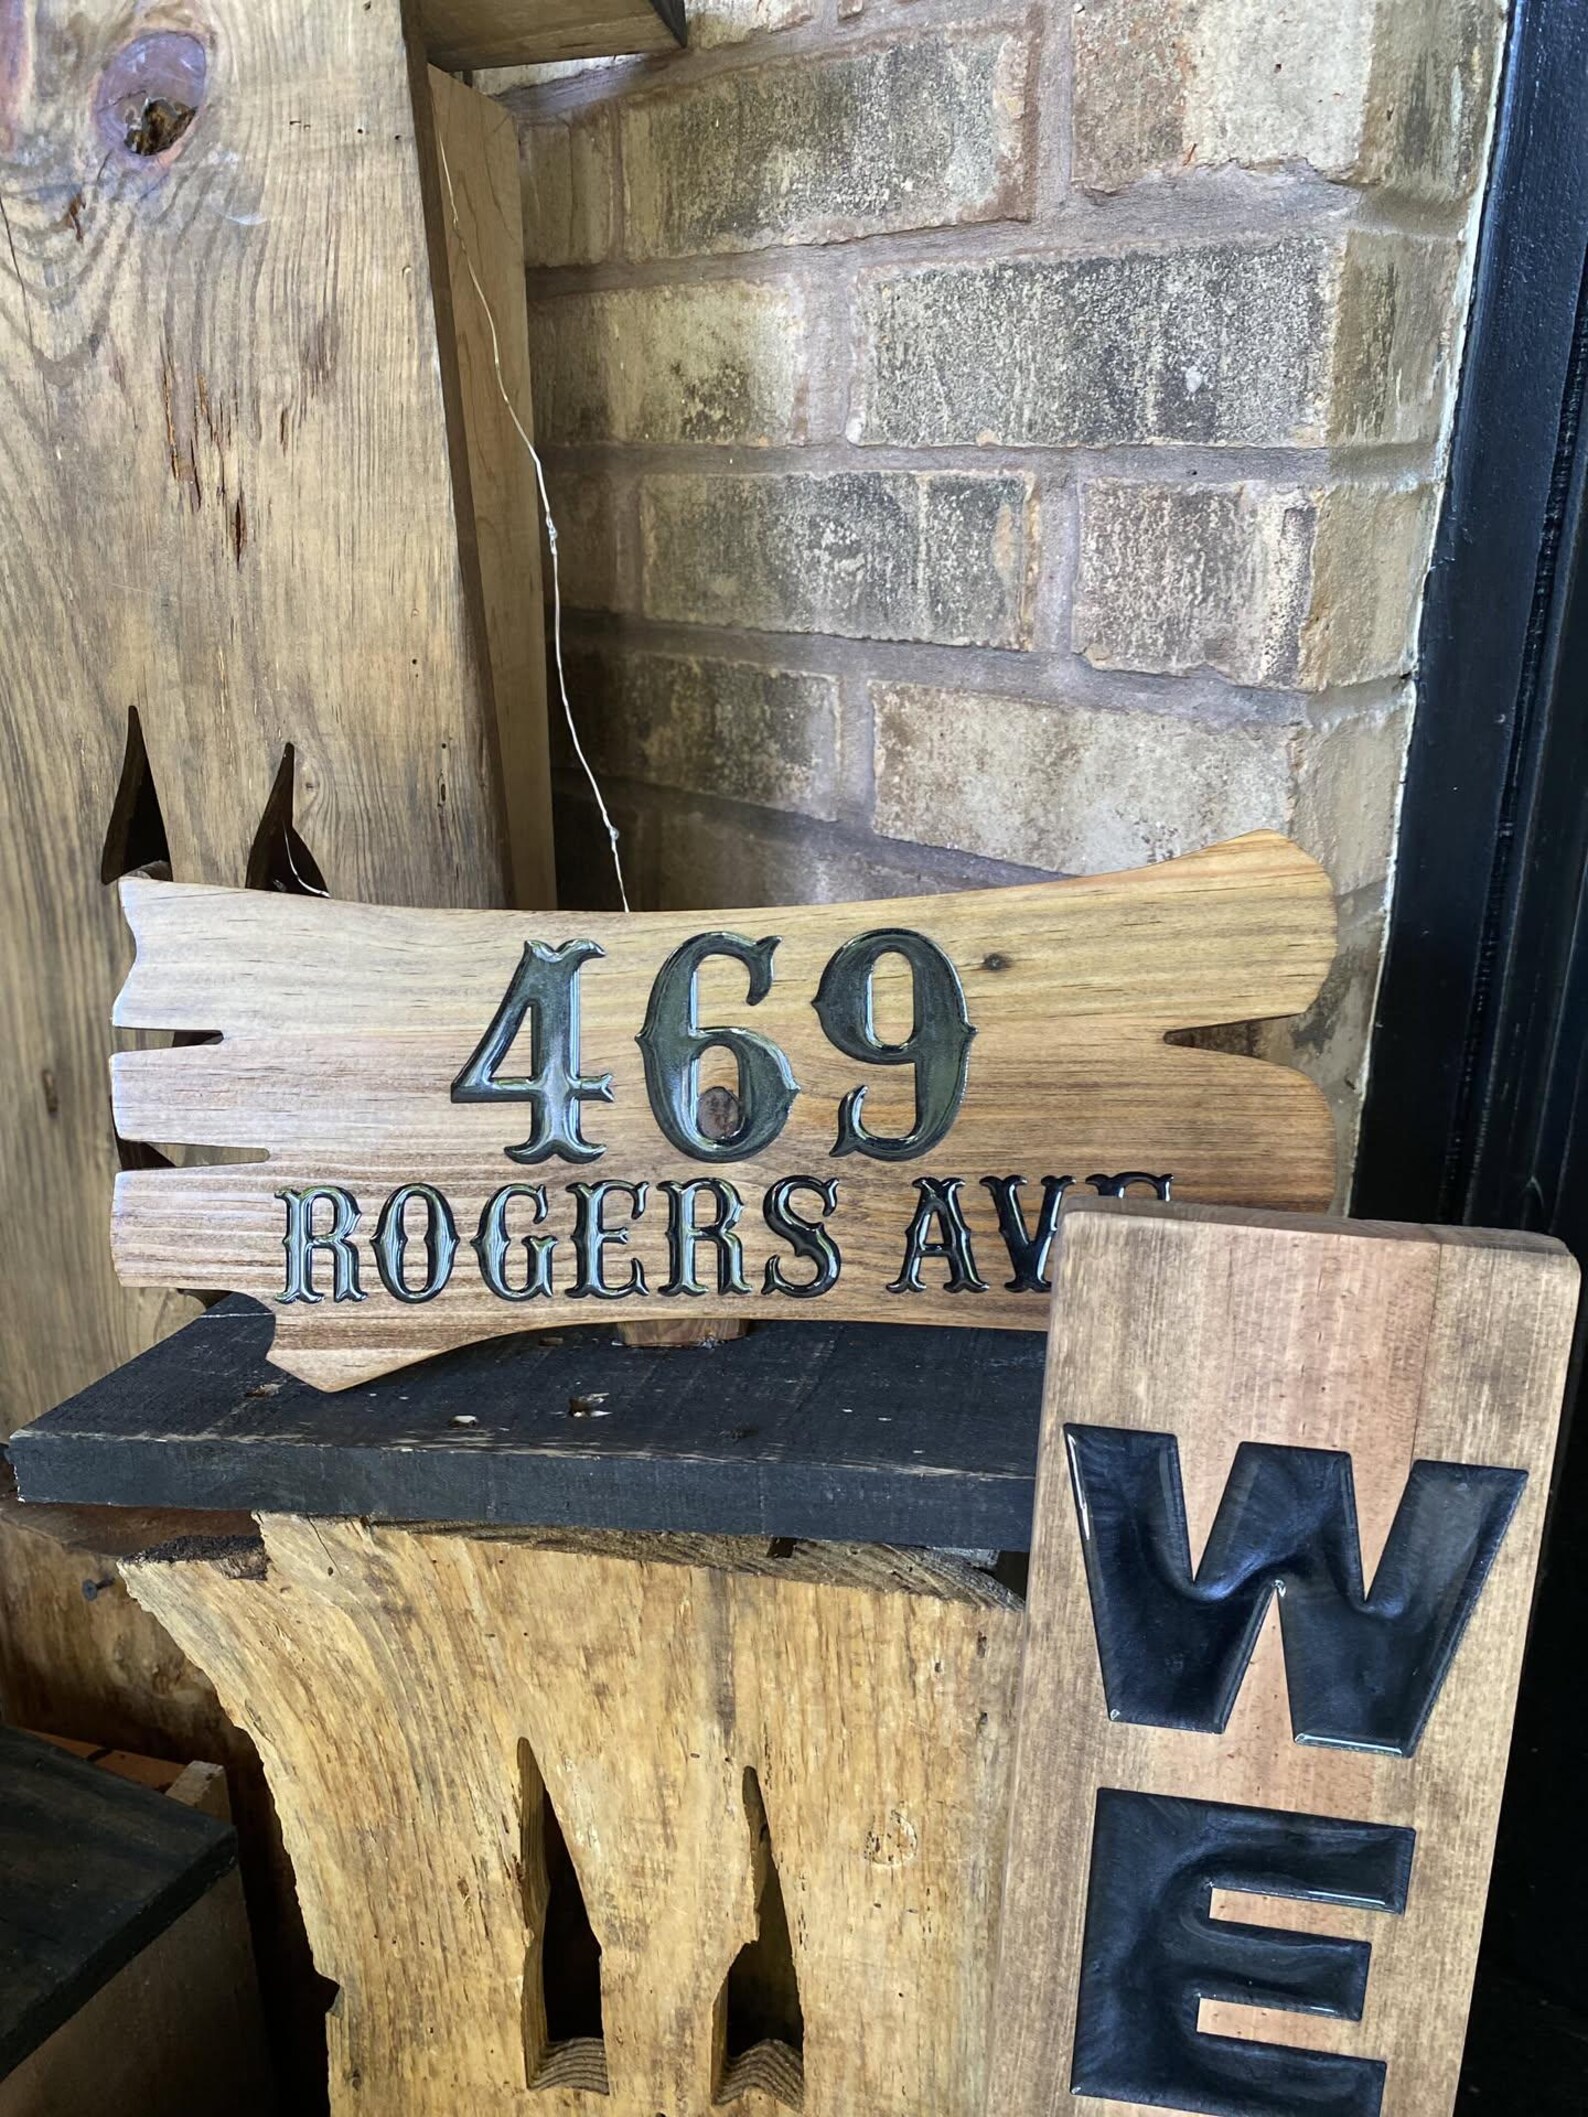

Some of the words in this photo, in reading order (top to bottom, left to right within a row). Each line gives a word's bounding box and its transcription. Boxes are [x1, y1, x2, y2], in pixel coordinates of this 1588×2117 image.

[450, 927, 977, 1164] 469
[274, 1174, 843, 1304] ROGERS
[885, 1171, 1174, 1293] AV
